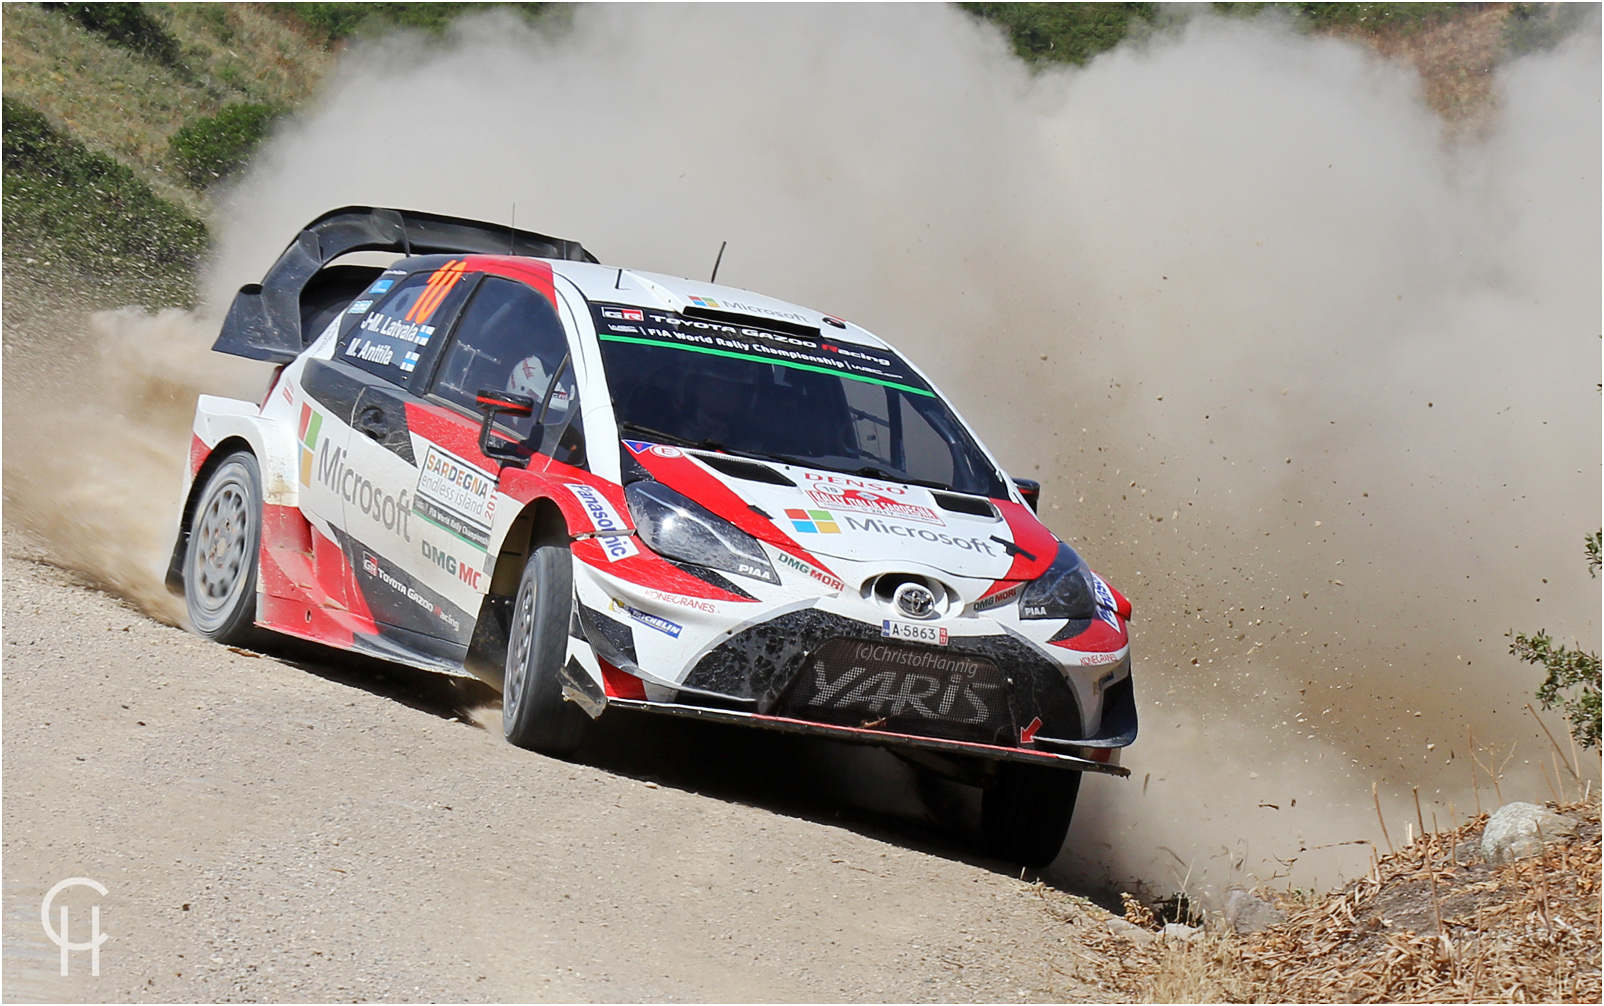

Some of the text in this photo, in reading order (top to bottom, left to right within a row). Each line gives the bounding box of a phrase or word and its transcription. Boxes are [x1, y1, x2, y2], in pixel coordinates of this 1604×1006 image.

[405, 259, 467, 324] 10
[360, 311, 419, 342] J-M. Latvala
[722, 299, 809, 324] Microsoft
[345, 337, 362, 357] M.
[357, 340, 394, 366] Anttila
[604, 310, 891, 366] GR TOYOTA GAZOO Racing
[647, 328, 672, 339] FIA
[673, 331, 713, 345] World
[716, 338, 750, 351] Rally
[752, 343, 845, 369] Championship
[317, 437, 412, 543] Microsoft
[421, 474, 486, 515] endless island
[426, 453, 489, 500] SARDEGNA
[804, 472, 905, 495] DENSO
[571, 484, 627, 557] Panasonic
[811, 490, 845, 505] RALLY
[844, 497, 880, 511] ITALIA
[880, 501, 937, 519] SARDEGNA
[844, 515, 998, 558] Microsoft
[421, 539, 457, 576] DMG
[738, 563, 771, 581] PIAA
[777, 552, 844, 592] DMG MORI
[378, 566, 407, 596] TOYOTA
[407, 587, 434, 613] GAZOO
[434, 605, 460, 632] Racing
[973, 588, 1017, 612] DMG MORI
[1024, 605, 1047, 616] PIAA
[632, 609, 681, 635] MICHELIN
